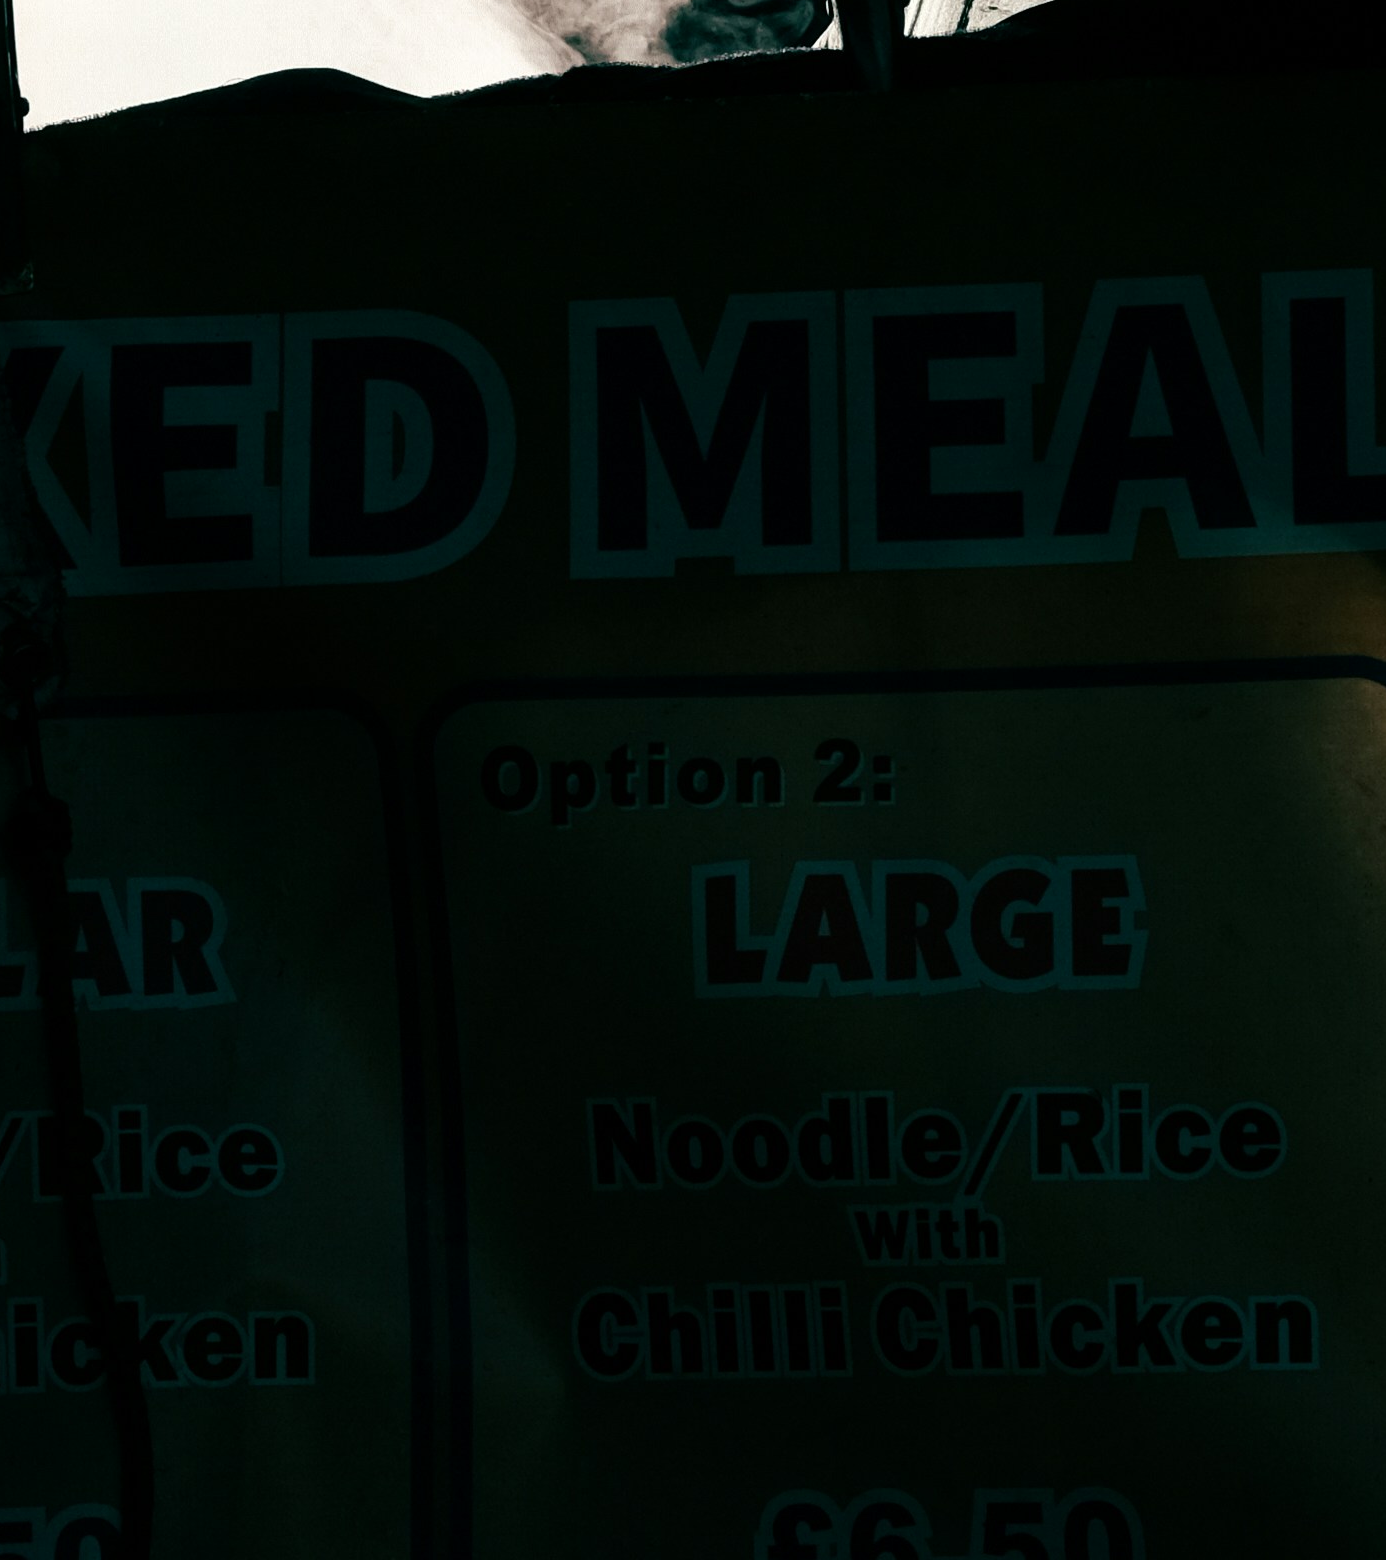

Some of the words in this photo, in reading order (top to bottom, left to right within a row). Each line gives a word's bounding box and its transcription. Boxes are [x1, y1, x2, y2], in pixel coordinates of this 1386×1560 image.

[479, 740, 787, 829] Option
[810, 737, 898, 808] 2:
[697, 861, 1139, 993] LARGE
[592, 1086, 1286, 1198] Noodle/Rice
[851, 1205, 1003, 1265] With
[576, 1283, 851, 1379] Chilli
[874, 1279, 1317, 1375] Chicken
